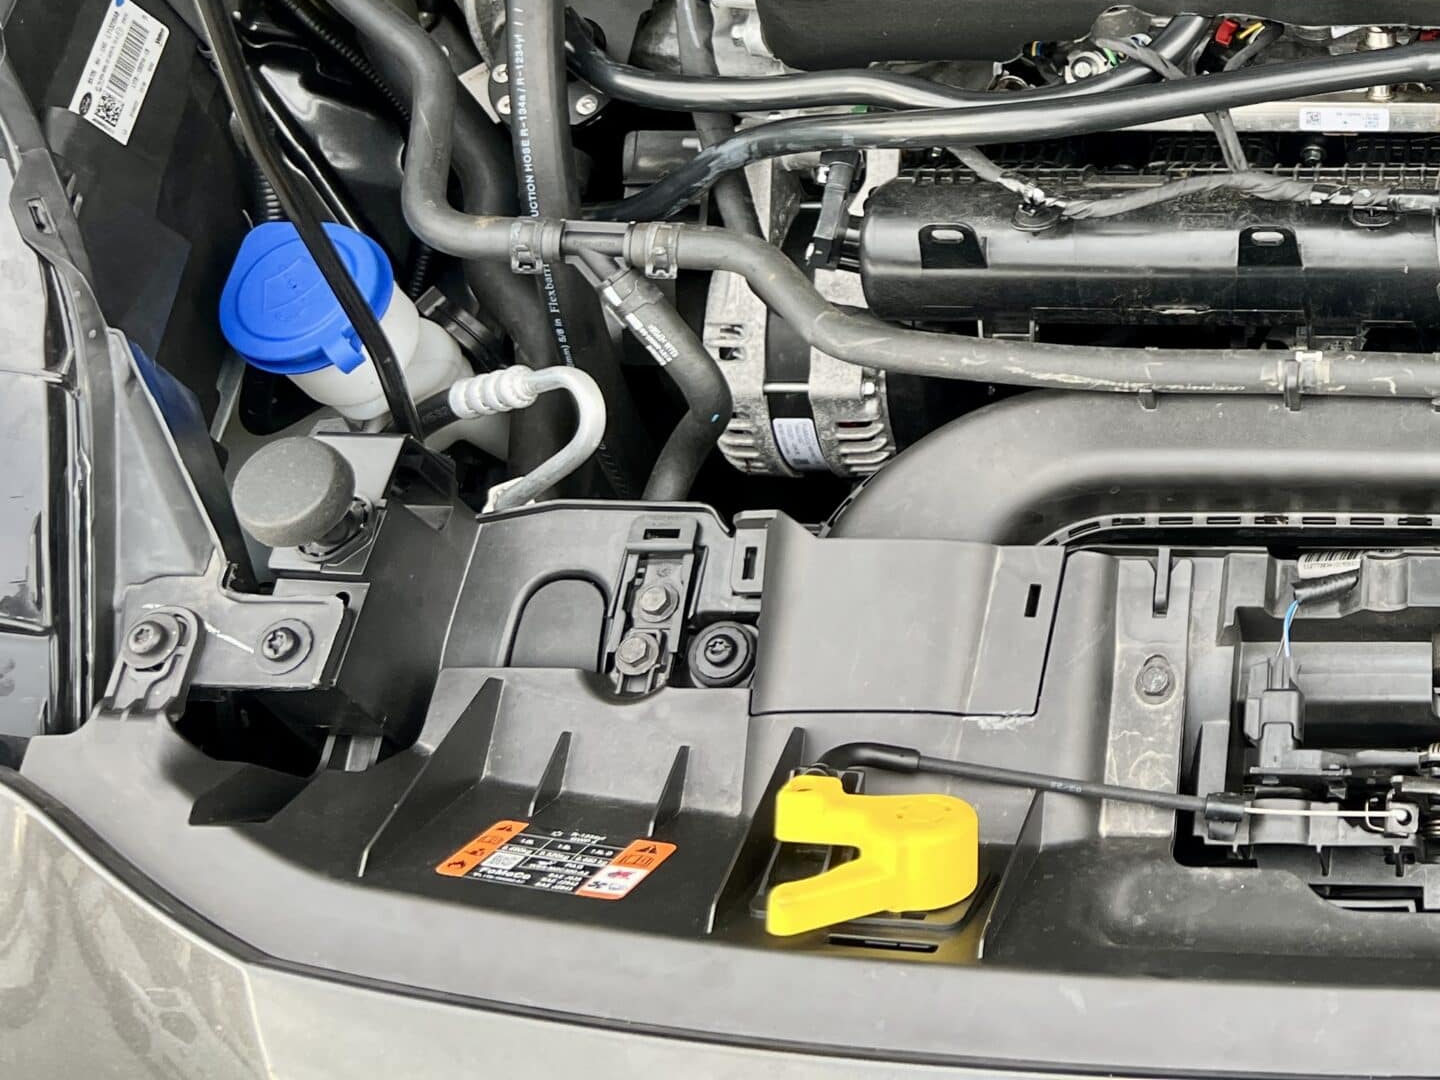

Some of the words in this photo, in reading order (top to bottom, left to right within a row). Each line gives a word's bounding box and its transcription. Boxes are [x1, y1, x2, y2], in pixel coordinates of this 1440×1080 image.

[521, 139, 533, 172] HOSE
[526, 175, 539, 217] UCTION
[543, 263, 560, 313] Flexbarri
